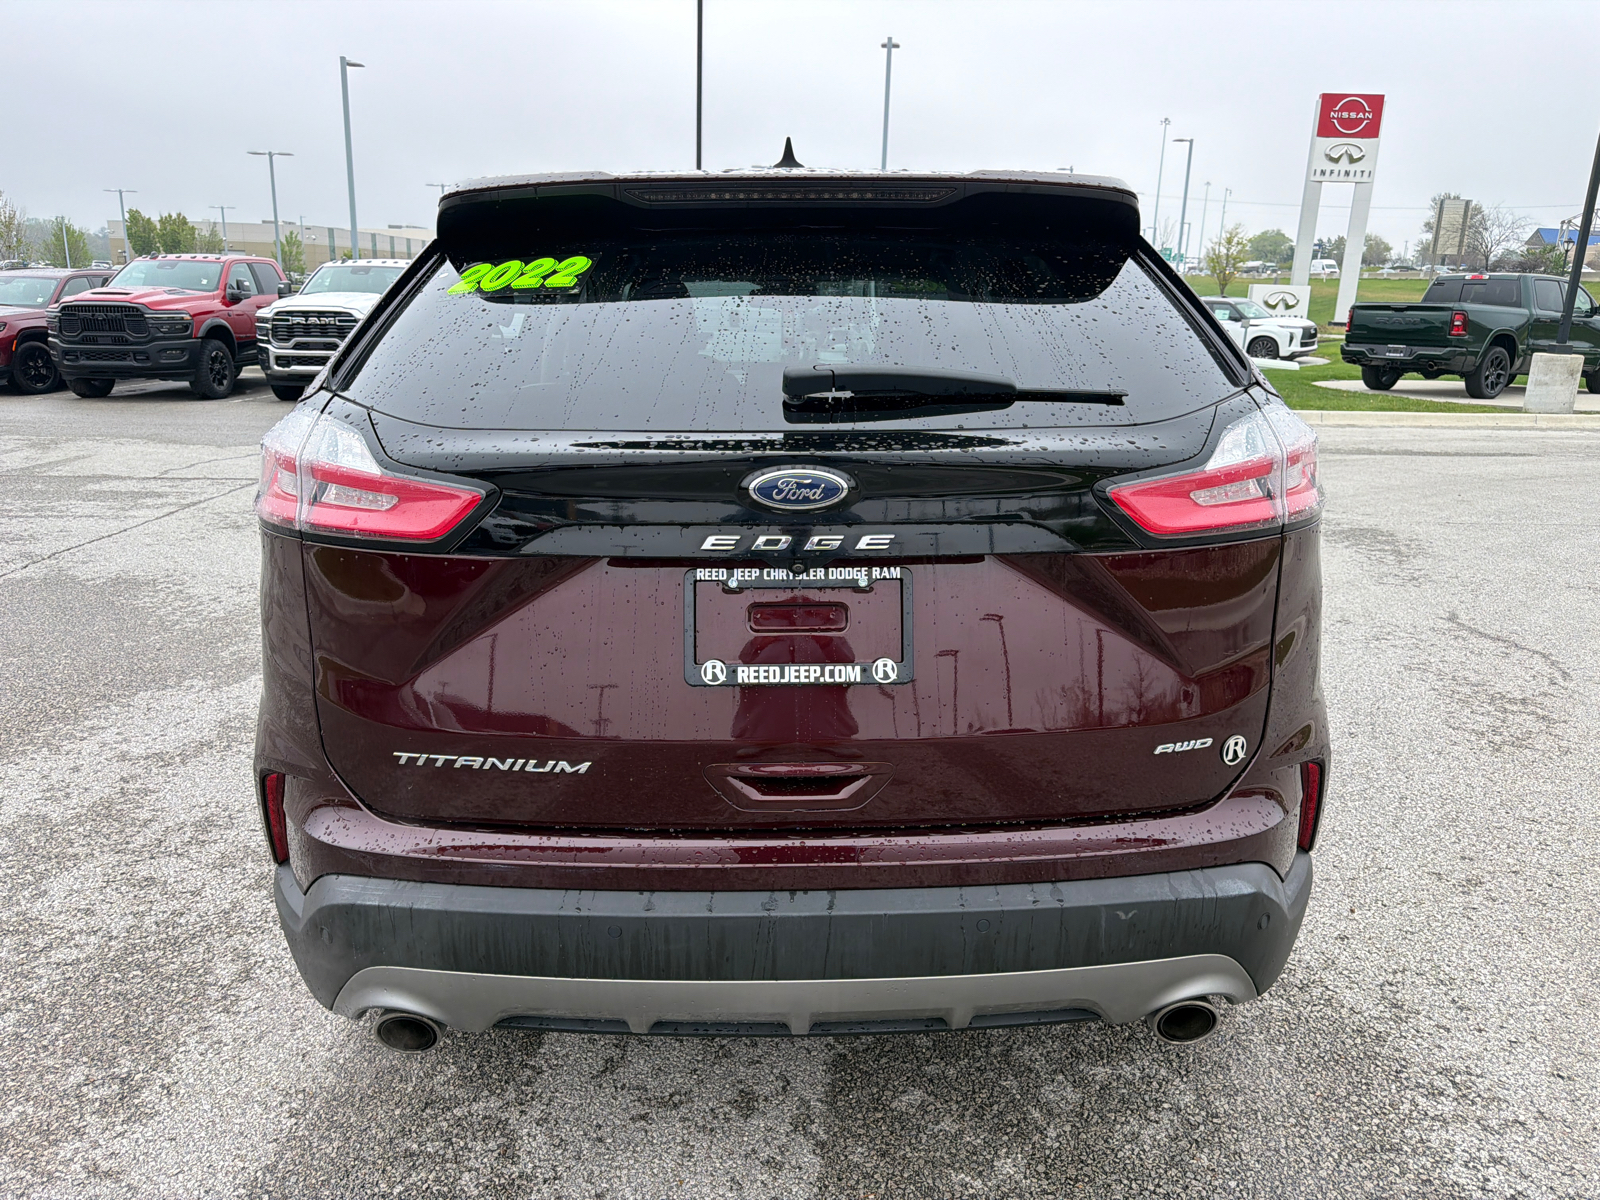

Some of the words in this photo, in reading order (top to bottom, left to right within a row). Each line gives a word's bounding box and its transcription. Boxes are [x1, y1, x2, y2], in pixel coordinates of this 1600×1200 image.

[1330, 111, 1373, 119] NISSAN
[1313, 168, 1372, 178] INFINITI
[446, 255, 593, 296] 2022
[291, 316, 335, 325] RAM
[772, 477, 826, 501] Ford
[699, 533, 896, 551] EDGE
[696, 568, 727, 581] REED
[732, 568, 760, 580] JEEP
[828, 567, 868, 580] DODGE
[872, 566, 901, 579] RAM
[737, 665, 861, 684] REEDJEEP.COM
[1153, 737, 1214, 755] AWD
[392, 751, 593, 775] TITANIUM
